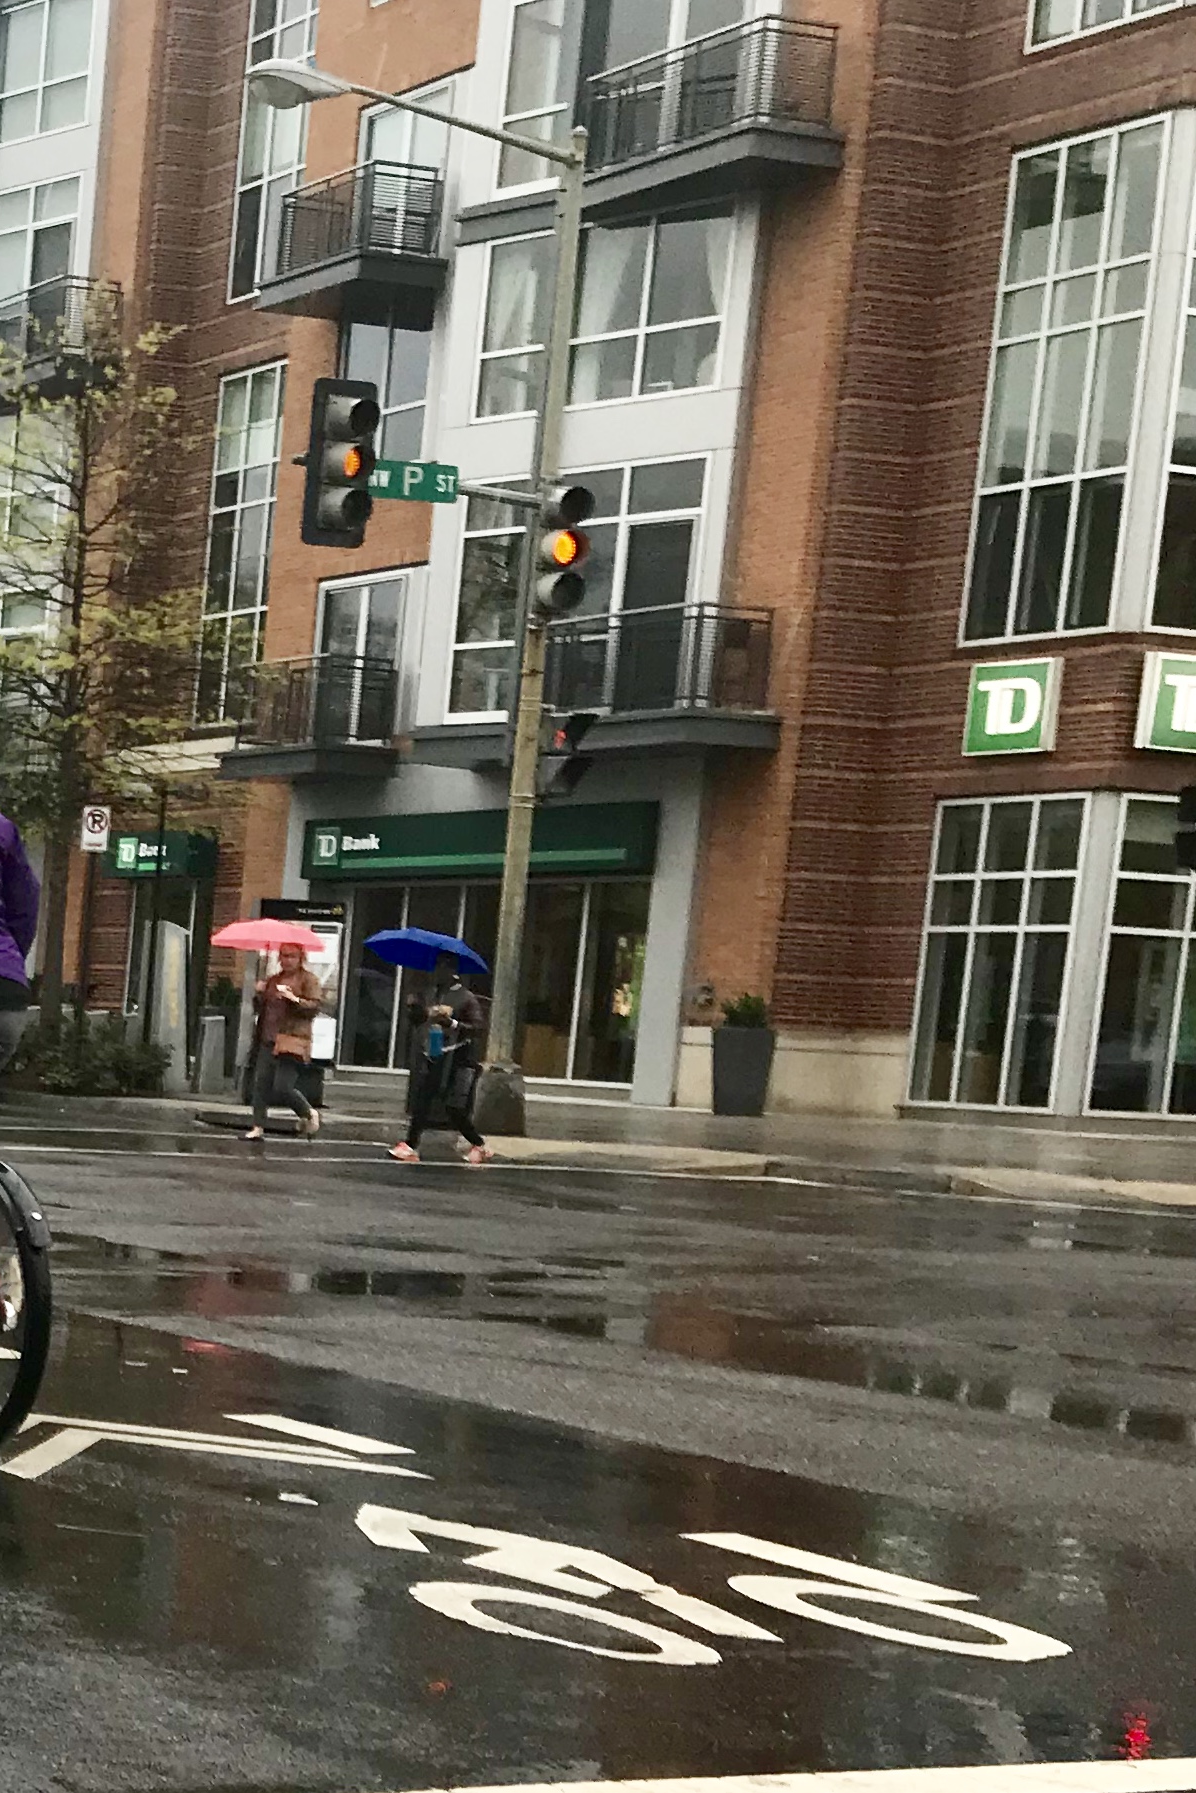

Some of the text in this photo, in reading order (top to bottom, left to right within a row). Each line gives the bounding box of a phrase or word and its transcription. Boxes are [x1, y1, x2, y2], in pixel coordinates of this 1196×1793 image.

[403, 465, 424, 496] P
[434, 474, 457, 493] ST
[977, 677, 1042, 735] TD
[1164, 674, 1196, 733] T
[119, 843, 136, 863] TD
[315, 833, 381, 858] TD Bank
